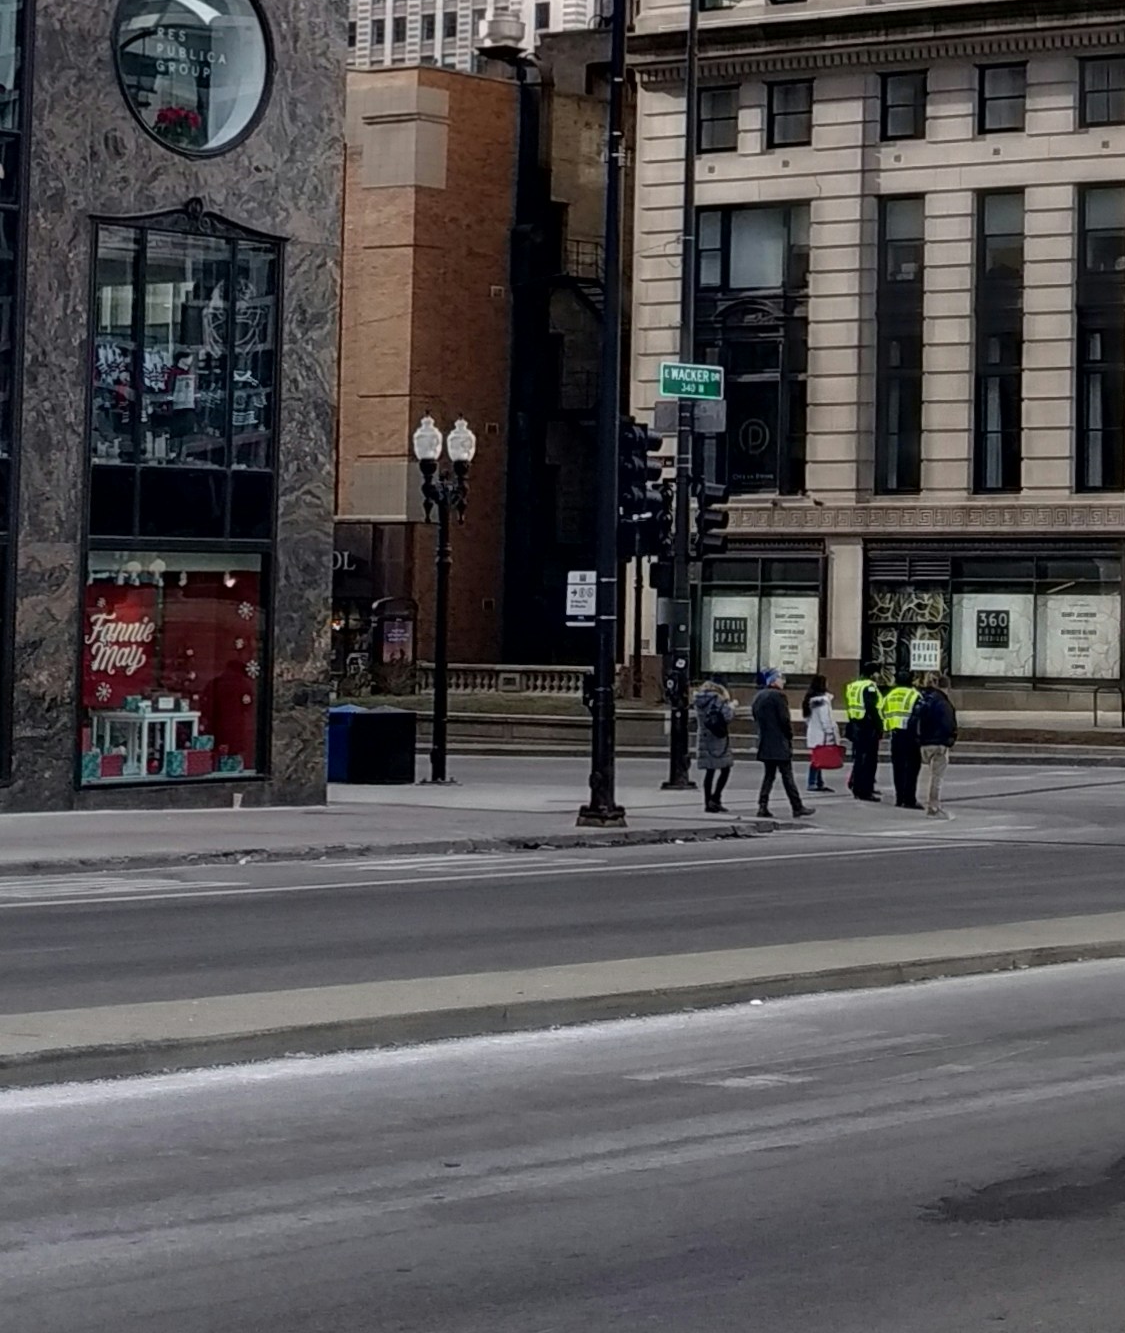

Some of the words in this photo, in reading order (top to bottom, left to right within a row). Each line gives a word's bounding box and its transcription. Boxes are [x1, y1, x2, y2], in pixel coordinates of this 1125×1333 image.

[157, 27, 186, 42] RES
[156, 43, 227, 65] PUBLICA
[156, 60, 210, 78] GROUP
[671, 367, 709, 383] WACKER
[711, 372, 720, 382] DR
[681, 382, 696, 393] 340
[715, 619, 745, 630] RETAIL
[979, 612, 1008, 628] 360
[84, 612, 155, 645] Fannie
[714, 633, 745, 643] SPACE
[912, 642, 938, 652] RETAIL
[91, 641, 147, 676] May
[912, 653, 938, 663] SPACE
